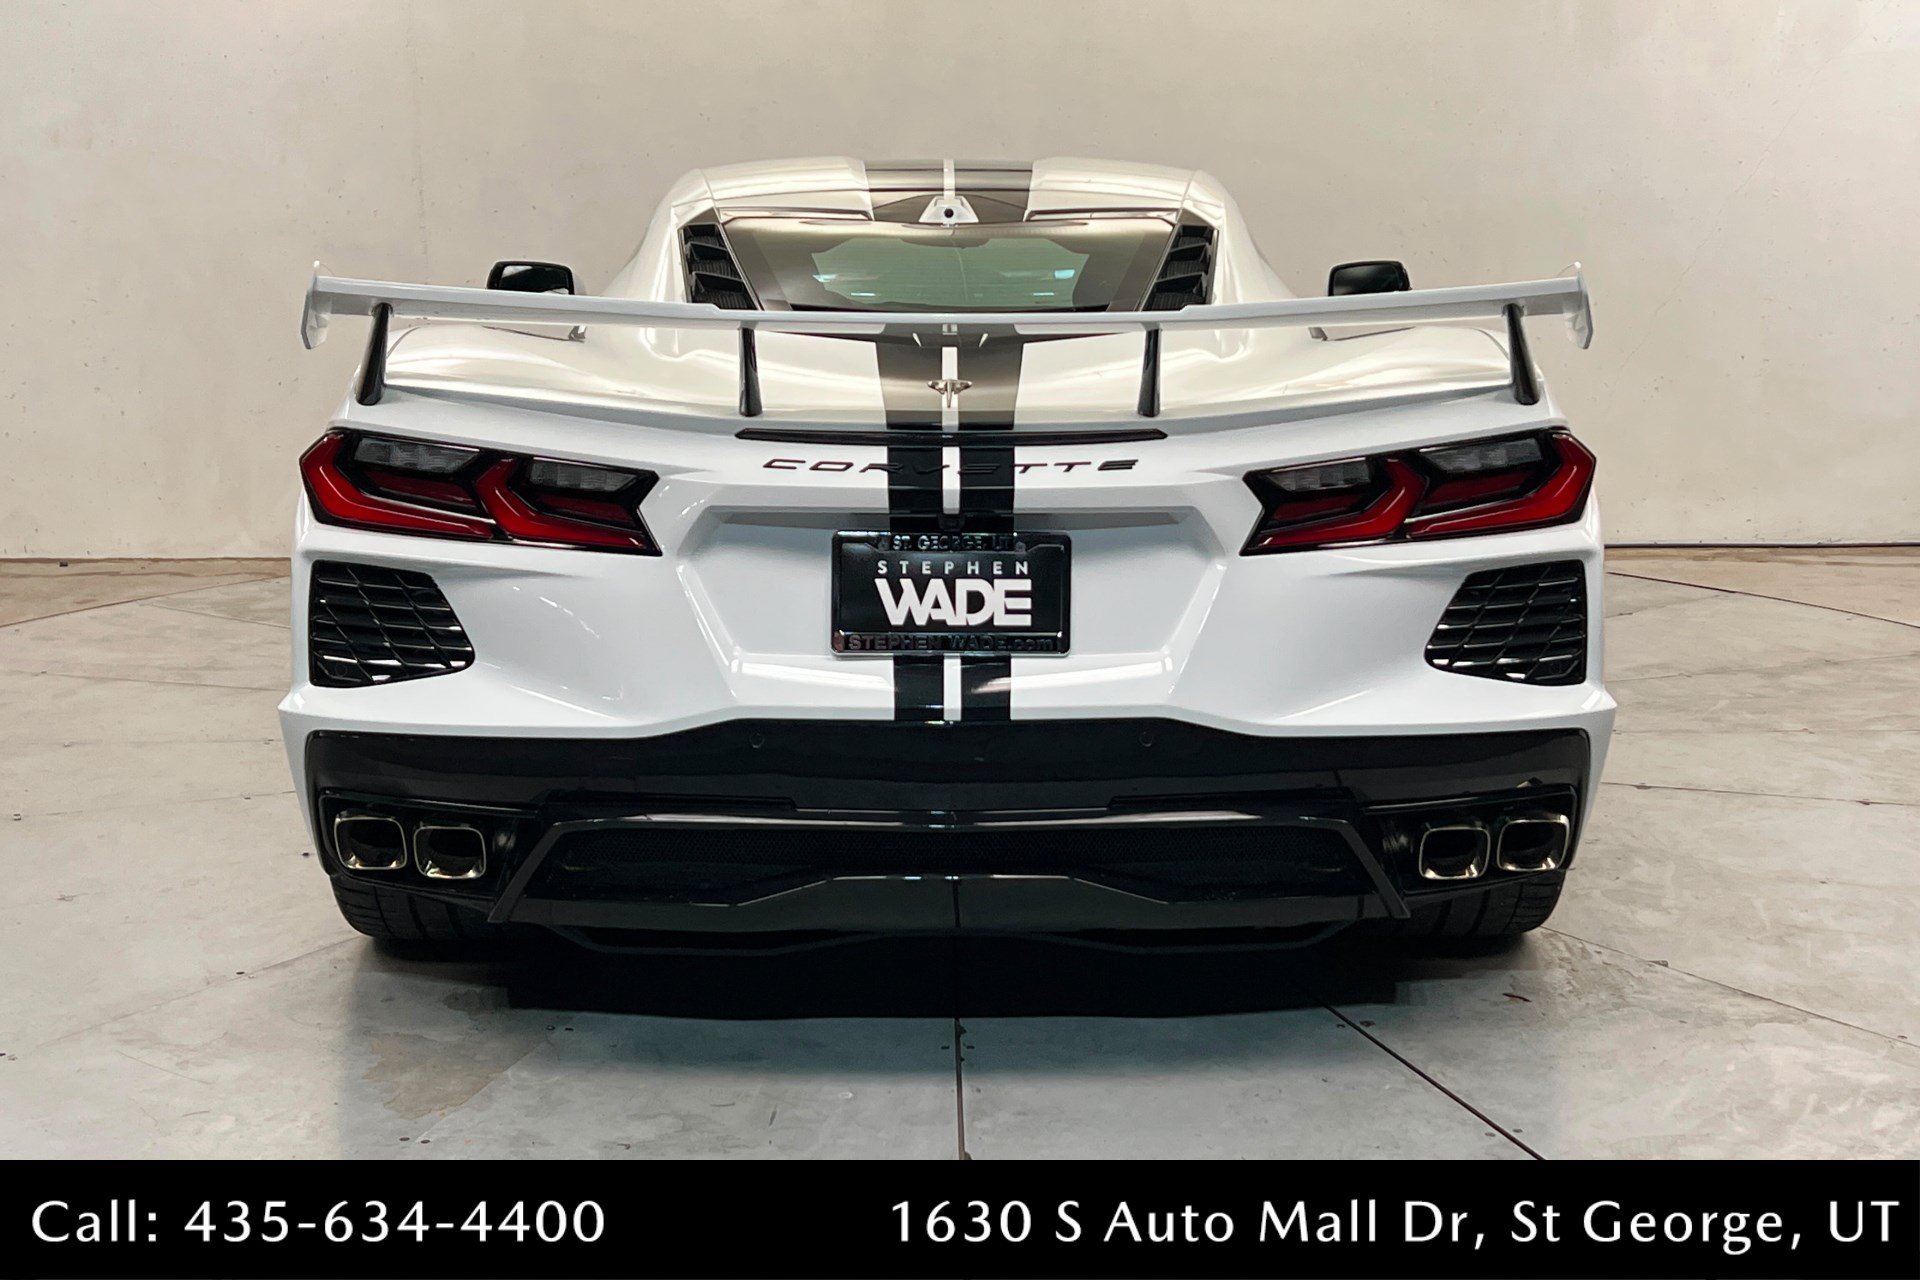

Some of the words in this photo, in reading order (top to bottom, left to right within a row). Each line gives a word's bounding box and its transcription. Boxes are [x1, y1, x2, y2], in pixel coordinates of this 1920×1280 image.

[763, 458, 1139, 475] CORVETTE
[877, 560, 1028, 575] STEPHEN
[874, 578, 1032, 626] WADE
[849, 634, 942, 650] STEPHEN
